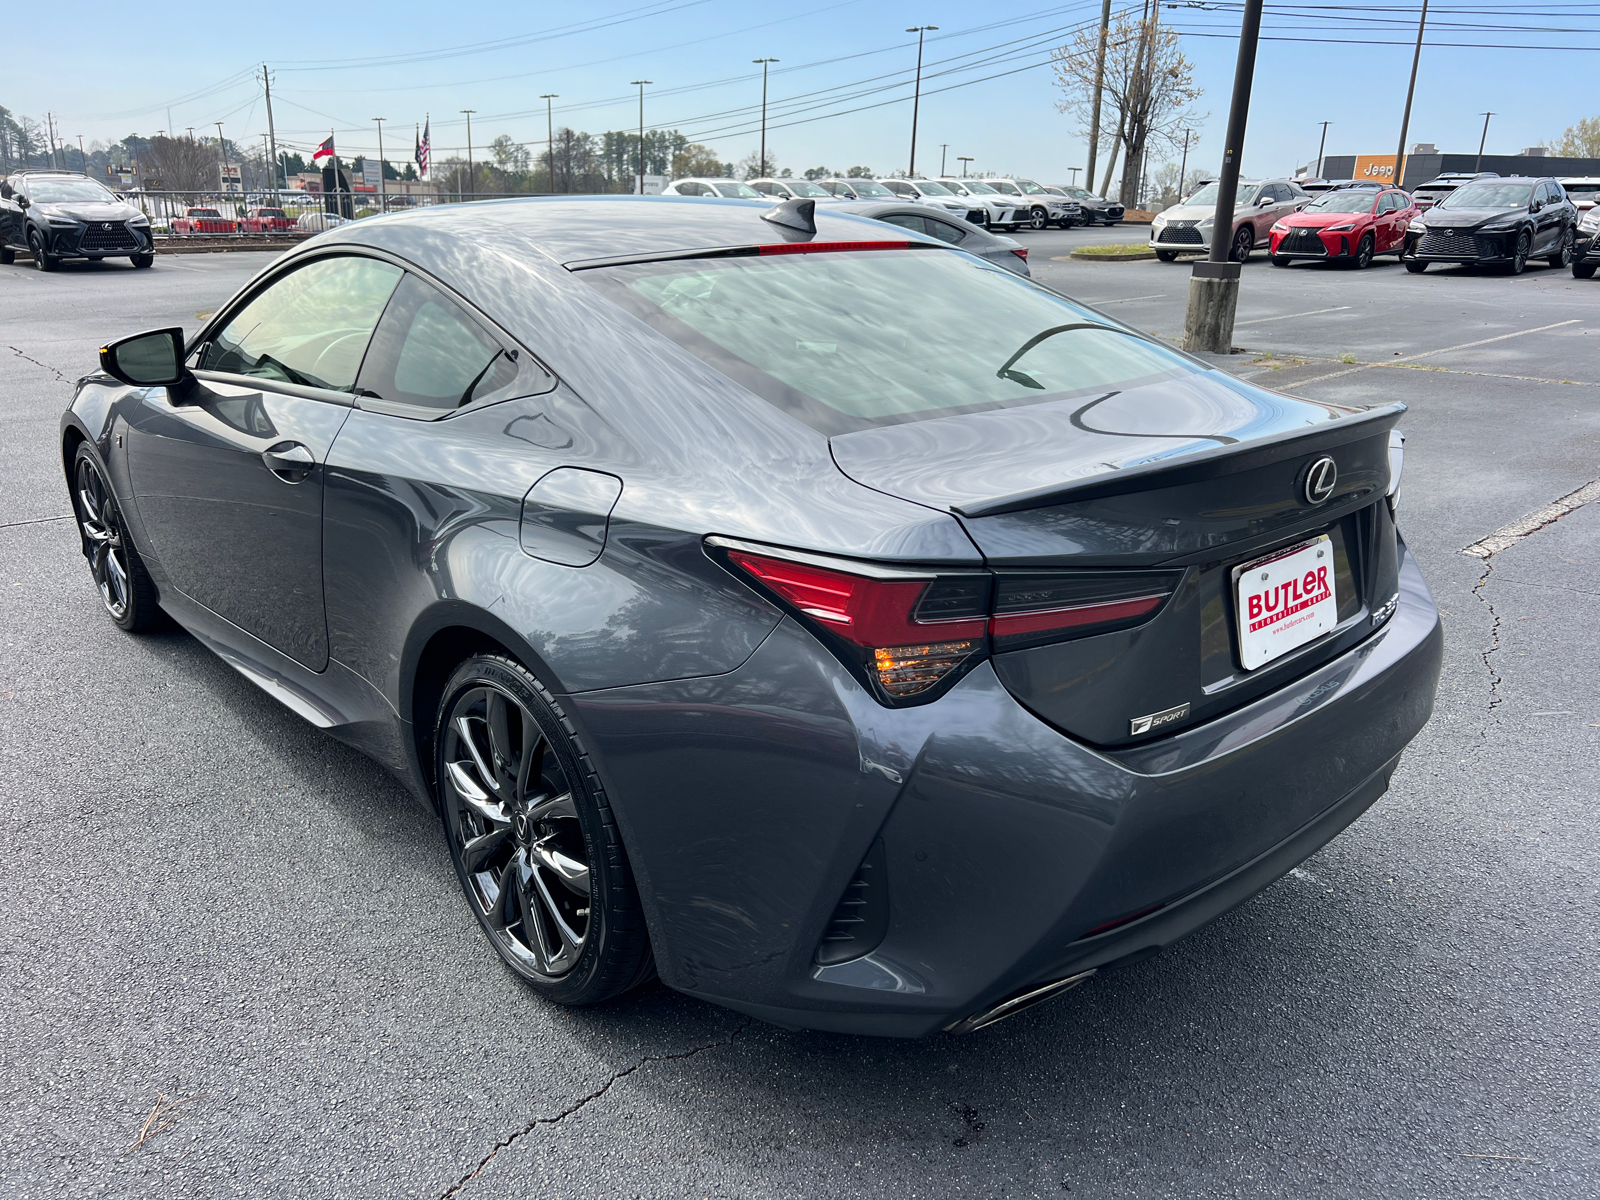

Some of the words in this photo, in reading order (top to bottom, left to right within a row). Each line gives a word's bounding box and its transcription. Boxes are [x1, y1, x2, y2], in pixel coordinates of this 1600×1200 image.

[1364, 163, 1394, 178] Jeep
[1250, 604, 1301, 632] AUTOMOTIVE
[1272, 612, 1315, 635] www.butlercars.com
[484, 666, 530, 698] DUNLOP
[1152, 708, 1187, 727] SPORT
